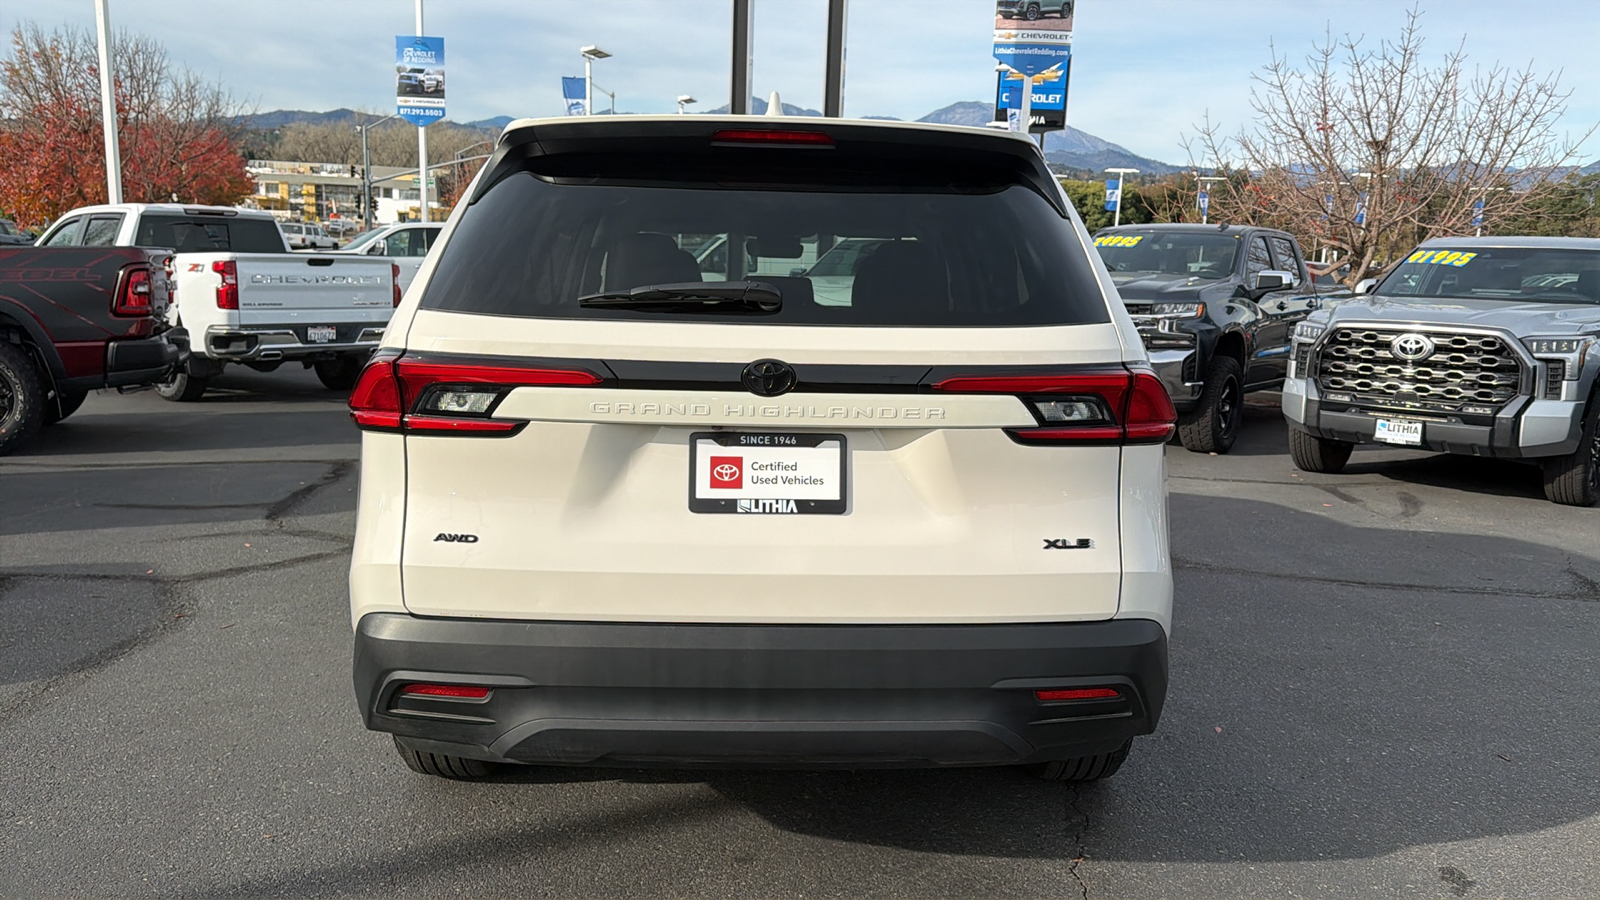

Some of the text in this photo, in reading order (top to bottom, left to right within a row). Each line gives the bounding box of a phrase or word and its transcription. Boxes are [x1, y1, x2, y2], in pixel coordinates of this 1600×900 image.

[1021, 32, 1069, 40] CHEVROLET
[995, 47, 1068, 56] LithiaChevroletRedding.com
[1002, 93, 1062, 104] CROLET
[400, 108, 443, 117] 877.293.5503
[251, 275, 381, 284] CHEVROLET
[589, 401, 946, 419] GRAND HIGHLANDER
[1387, 423, 1419, 435] LITHIA
[740, 436, 797, 445] SINCE 1946
[751, 461, 798, 471] Certified
[751, 475, 824, 485] Used Vehicles
[751, 499, 798, 513] LITHIA
[433, 533, 479, 543] AWD
[1043, 538, 1092, 549] XLE
